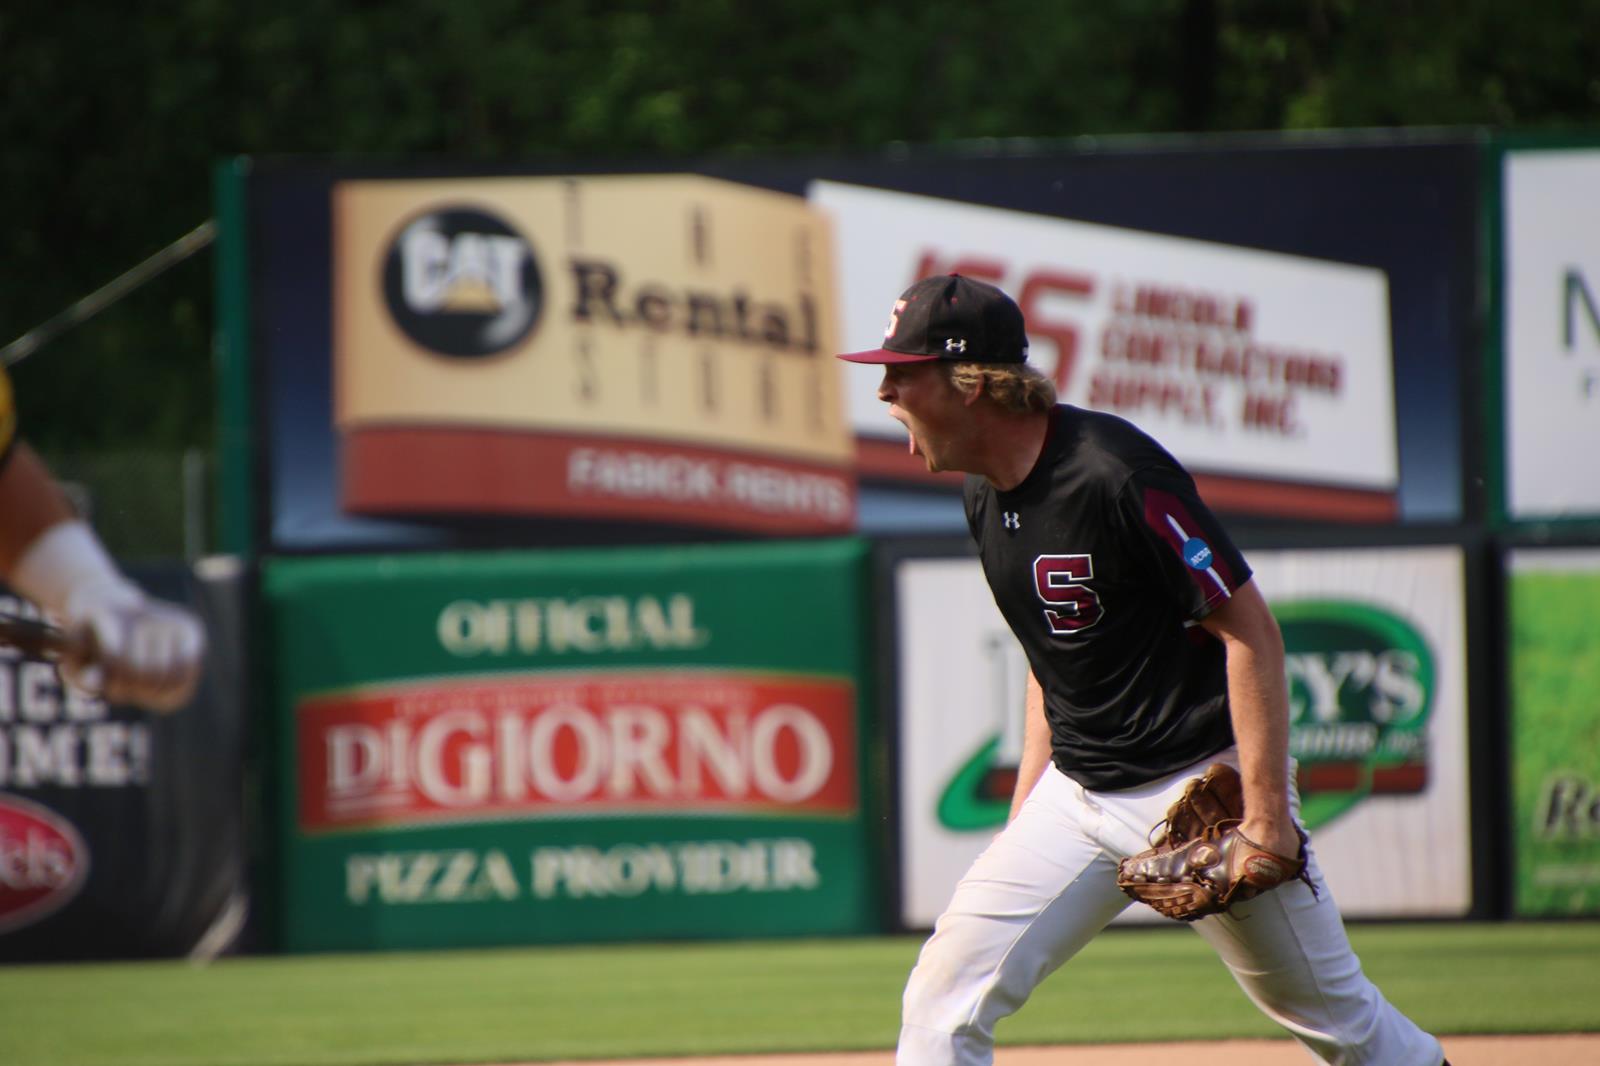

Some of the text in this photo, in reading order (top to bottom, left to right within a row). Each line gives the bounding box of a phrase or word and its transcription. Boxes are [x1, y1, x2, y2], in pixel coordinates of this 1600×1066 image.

[569, 258, 820, 355] Rental
[437, 593, 708, 657] OFFICIAL
[1033, 553, 1105, 633] S
[346, 837, 820, 905] PIZZA PROVIDER
